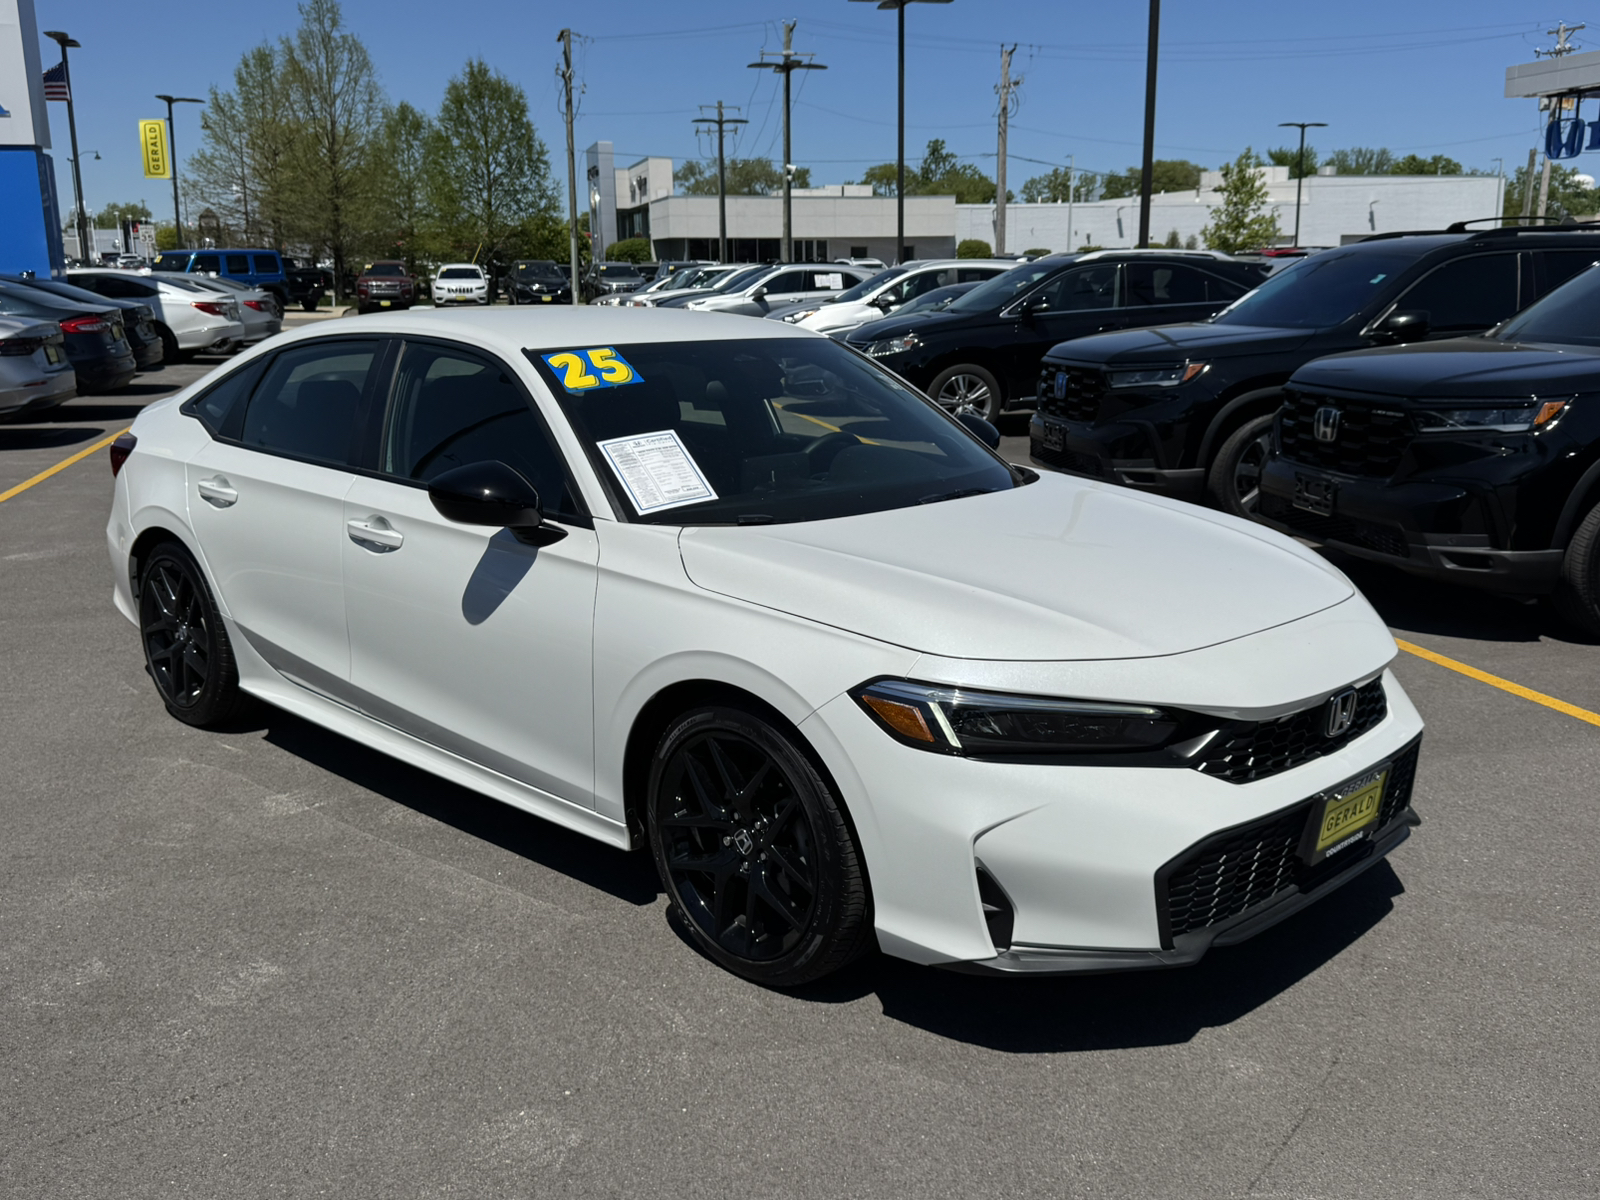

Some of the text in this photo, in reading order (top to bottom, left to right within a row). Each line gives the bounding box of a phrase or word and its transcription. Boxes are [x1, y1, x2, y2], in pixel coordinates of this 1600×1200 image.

[148, 127, 161, 171] GERALD
[548, 348, 633, 388] 25
[1326, 795, 1374, 832] GERALD
